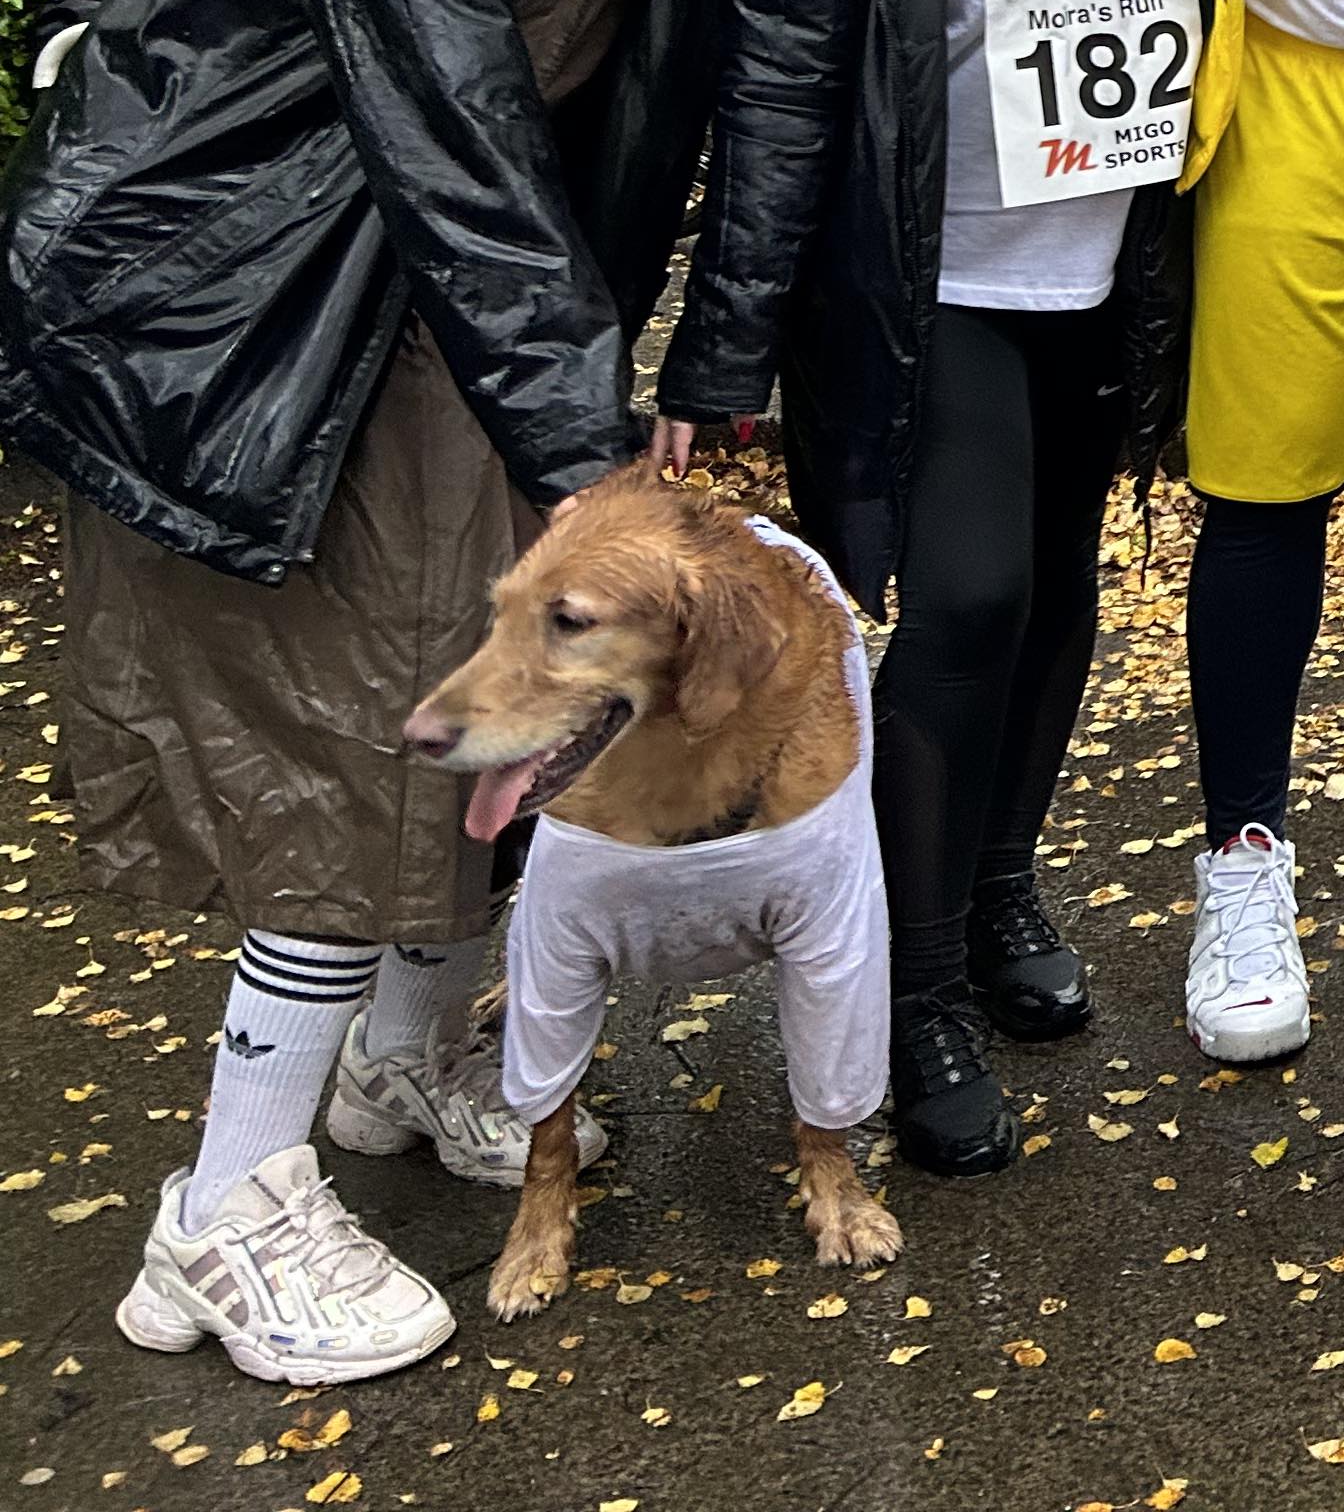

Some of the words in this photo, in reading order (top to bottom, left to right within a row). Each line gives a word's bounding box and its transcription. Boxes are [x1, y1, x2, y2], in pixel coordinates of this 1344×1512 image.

[1015, 20, 1192, 126] 182
[1114, 119, 1175, 145] MIGO
[1103, 138, 1185, 169] SPORTS
